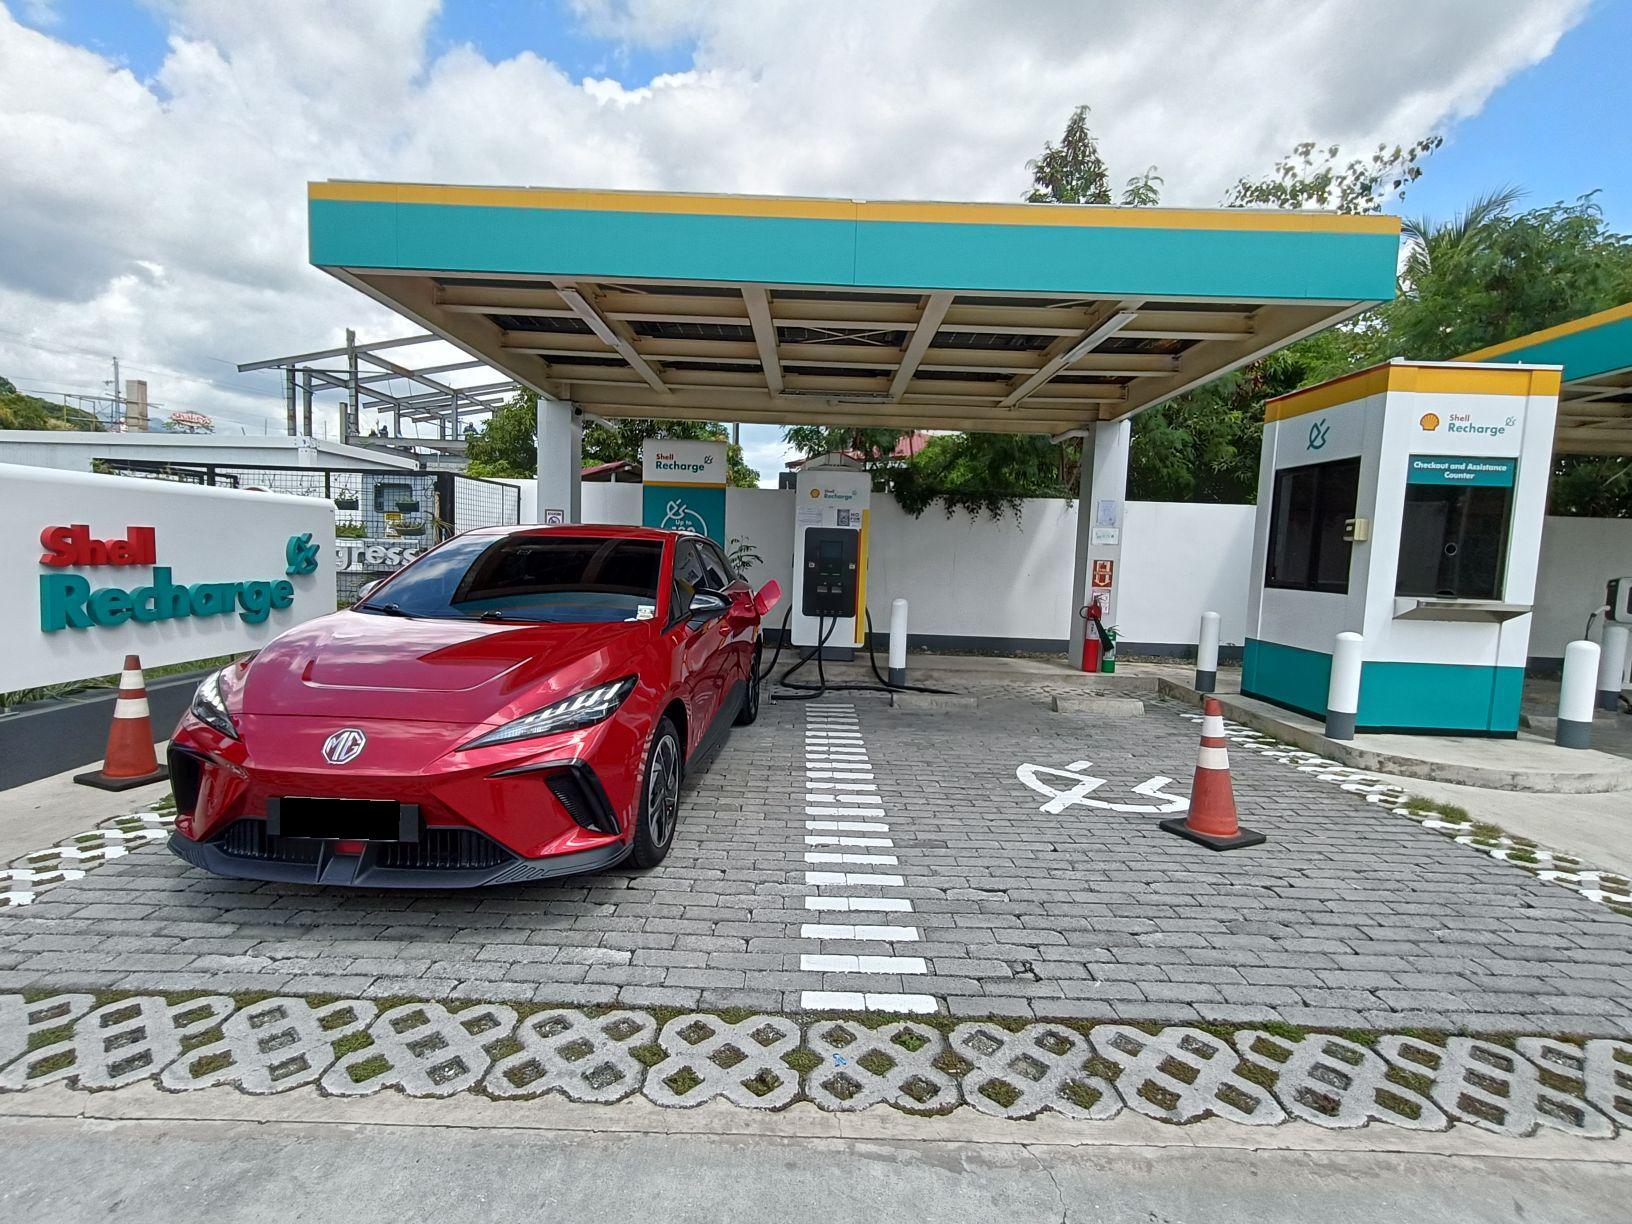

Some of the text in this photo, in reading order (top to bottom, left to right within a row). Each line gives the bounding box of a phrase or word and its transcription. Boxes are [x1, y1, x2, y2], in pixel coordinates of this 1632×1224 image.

[1449, 414, 1470, 422] Shell
[1448, 423, 1505, 436] Recharge
[655, 461, 704, 473] Recharge
[1413, 461, 1448, 469] Checkout
[1467, 463, 1507, 472] Assistance
[1444, 471, 1475, 479] Counter
[824, 493, 852, 501] Recharge
[39, 524, 156, 567] Shell
[39, 566, 294, 633] Recharge
[325, 730, 363, 762] MG
